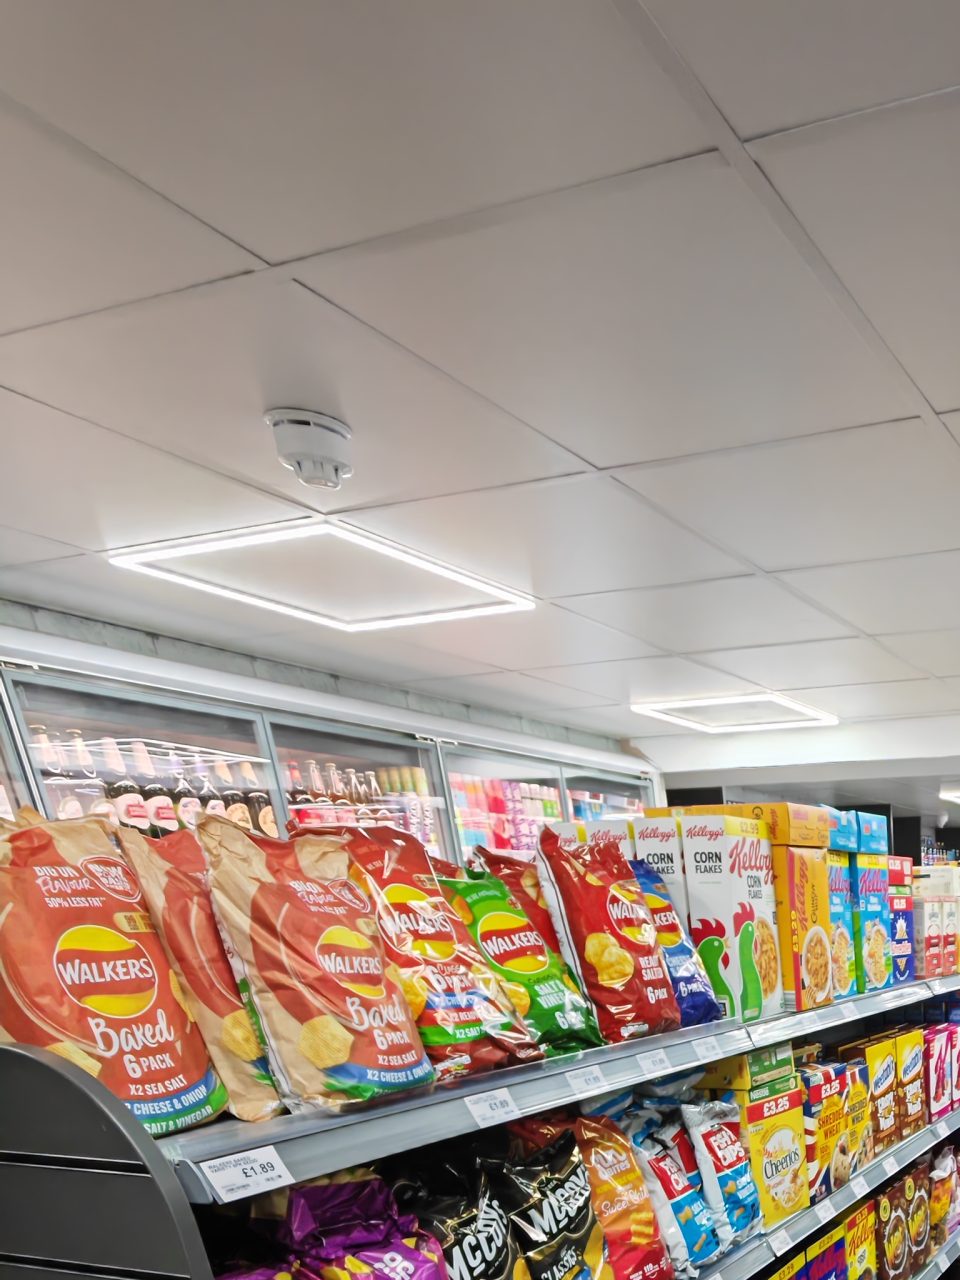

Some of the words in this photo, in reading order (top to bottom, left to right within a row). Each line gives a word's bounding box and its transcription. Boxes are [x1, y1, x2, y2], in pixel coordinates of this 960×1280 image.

[638, 827, 676, 840] Kellogg's
[686, 826, 724, 841] Kellogg's
[646, 853, 674, 865] CORN
[694, 851, 722, 864] CORN
[695, 865, 722, 874] FLAKES
[746, 876, 762, 888] CORN
[482, 931, 543, 956] WALKERS
[58, 958, 154, 985] WALKERS
[320, 952, 383, 975] WALKERS
[647, 986, 655, 1004] 6
[679, 981, 689, 996] 6
[346, 994, 406, 1032] Baked
[554, 1011, 569, 1029] 6
[88, 1008, 175, 1058] Baked
[373, 1030, 388, 1050] 6
[388, 1030, 411, 1046] PACK
[455, 1027, 467, 1038] X2
[123, 1053, 142, 1079] 6
[142, 1053, 175, 1072] PACK
[377, 1054, 389, 1064] X2
[389, 1053, 403, 1065] SEA
[403, 1051, 418, 1063] SALT
[366, 1069, 379, 1081] X2
[380, 1068, 407, 1082] CHEESE
[129, 1083, 144, 1096] X2
[146, 1081, 166, 1096] SEA
[165, 1074, 188, 1091] SALT
[821, 1080, 840, 1095] £3.25
[134, 1099, 175, 1116] CHEESE
[175, 1097, 182, 1110] &
[182, 1086, 208, 1107] ONION
[763, 1097, 790, 1116] £3.25
[144, 1120, 167, 1134] SALT
[168, 1119, 175, 1131] &
[176, 1105, 214, 1130] VINEGAR
[818, 1109, 845, 1130] SHREDDED
[824, 1123, 841, 1139] WHEAT
[242, 1162, 275, 1179] £1.89
[764, 1146, 800, 1180] Cheerios
